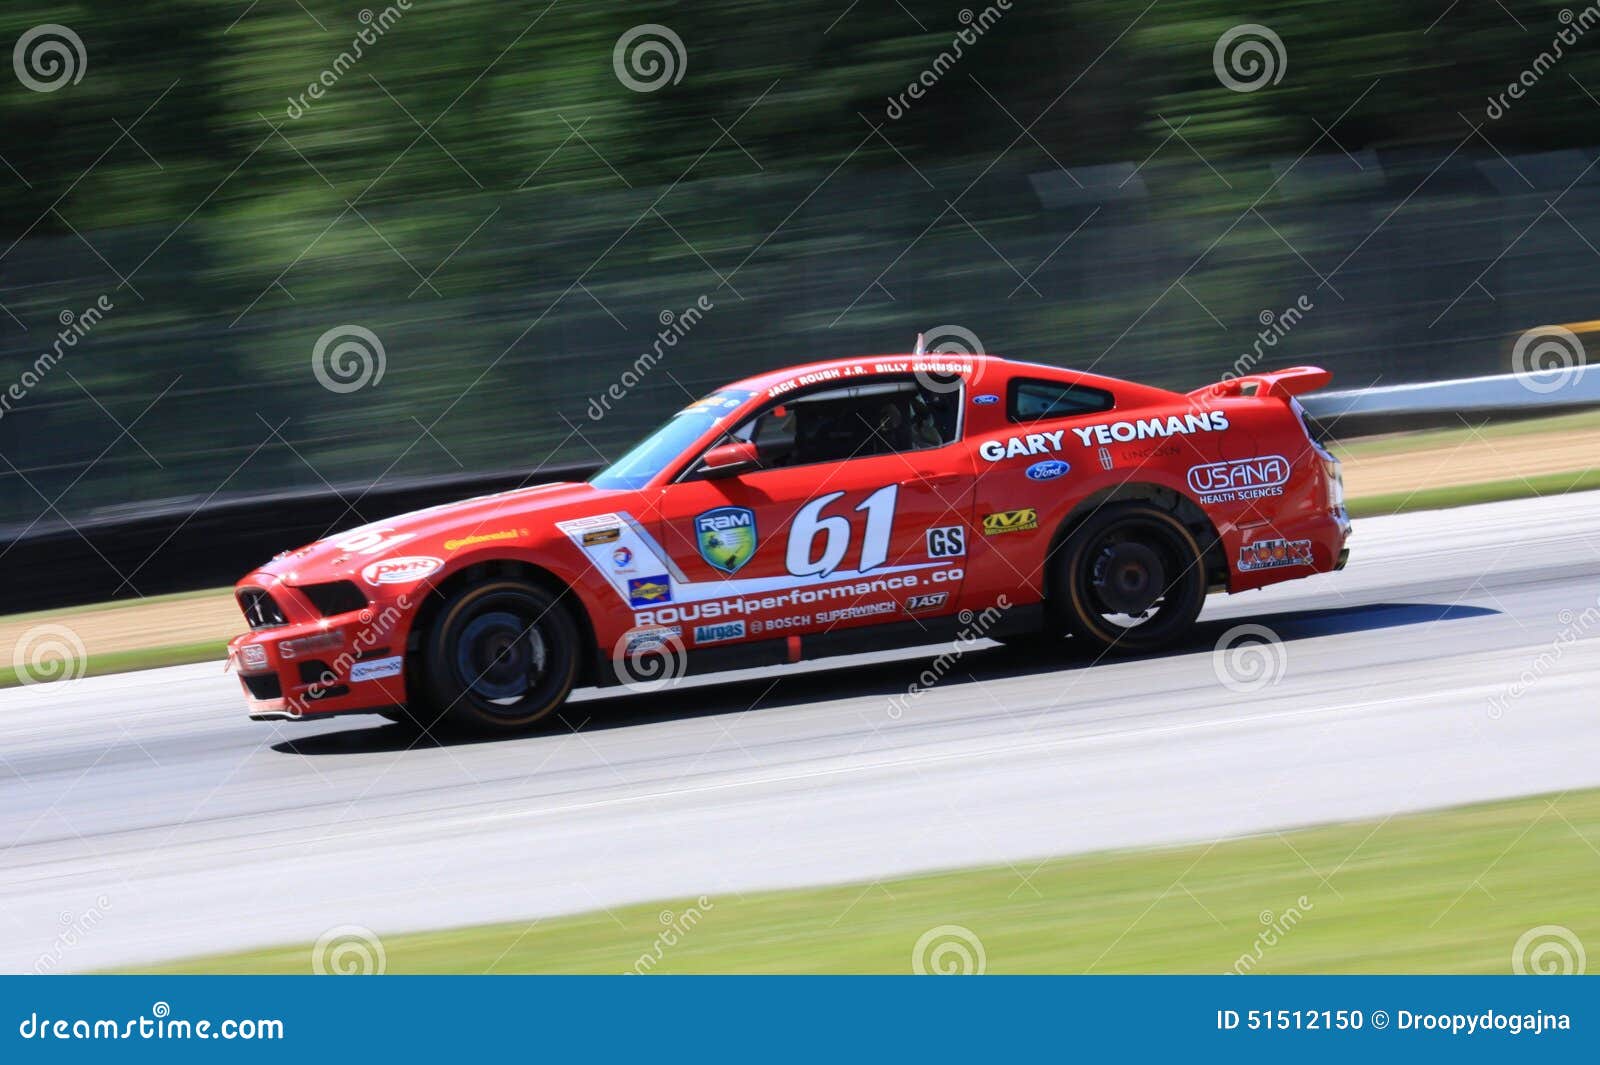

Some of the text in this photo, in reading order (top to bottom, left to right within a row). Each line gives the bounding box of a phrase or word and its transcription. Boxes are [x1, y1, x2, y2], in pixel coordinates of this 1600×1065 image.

[875, 363, 973, 373] BILLY JOHNSON
[768, 366, 868, 397] JACK ROUSH J.R.
[979, 410, 1230, 461] GARY YEOMANS
[1194, 460, 1282, 489] USANA
[1200, 487, 1283, 505] HEALTH SCIENCES
[785, 483, 901, 579] 61
[929, 527, 963, 557] GS
[765, 615, 811, 630] BOSCH
[815, 601, 896, 624] SUPERWINCH
[696, 622, 743, 642] Airgas
